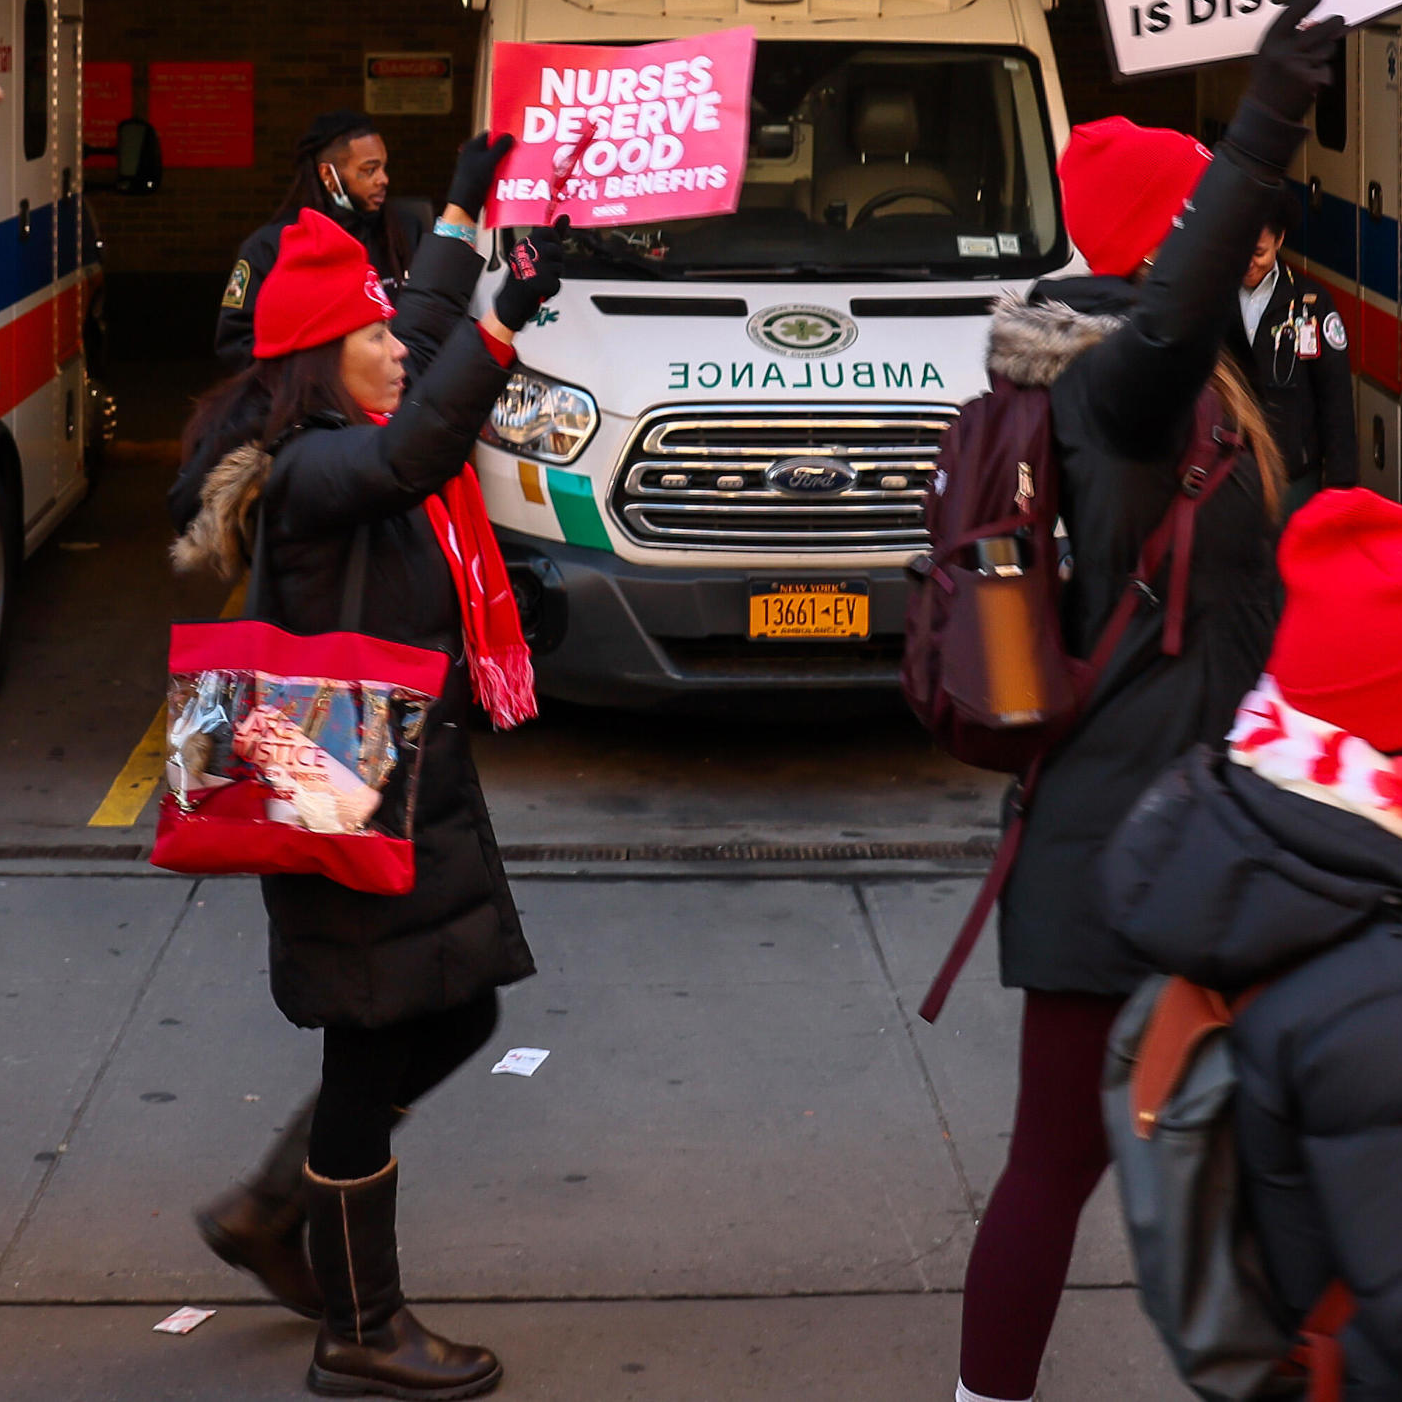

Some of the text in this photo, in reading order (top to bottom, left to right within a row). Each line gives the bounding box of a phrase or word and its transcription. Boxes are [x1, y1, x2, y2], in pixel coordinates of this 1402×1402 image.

[1130, 0, 1171, 36] IS
[541, 54, 714, 106] NURSES
[523, 90, 722, 143] DESERVE
[496, 164, 729, 202] HEATH BENEFITS
[789, 466, 837, 488] Ford
[779, 583, 839, 593] NEW YORK
